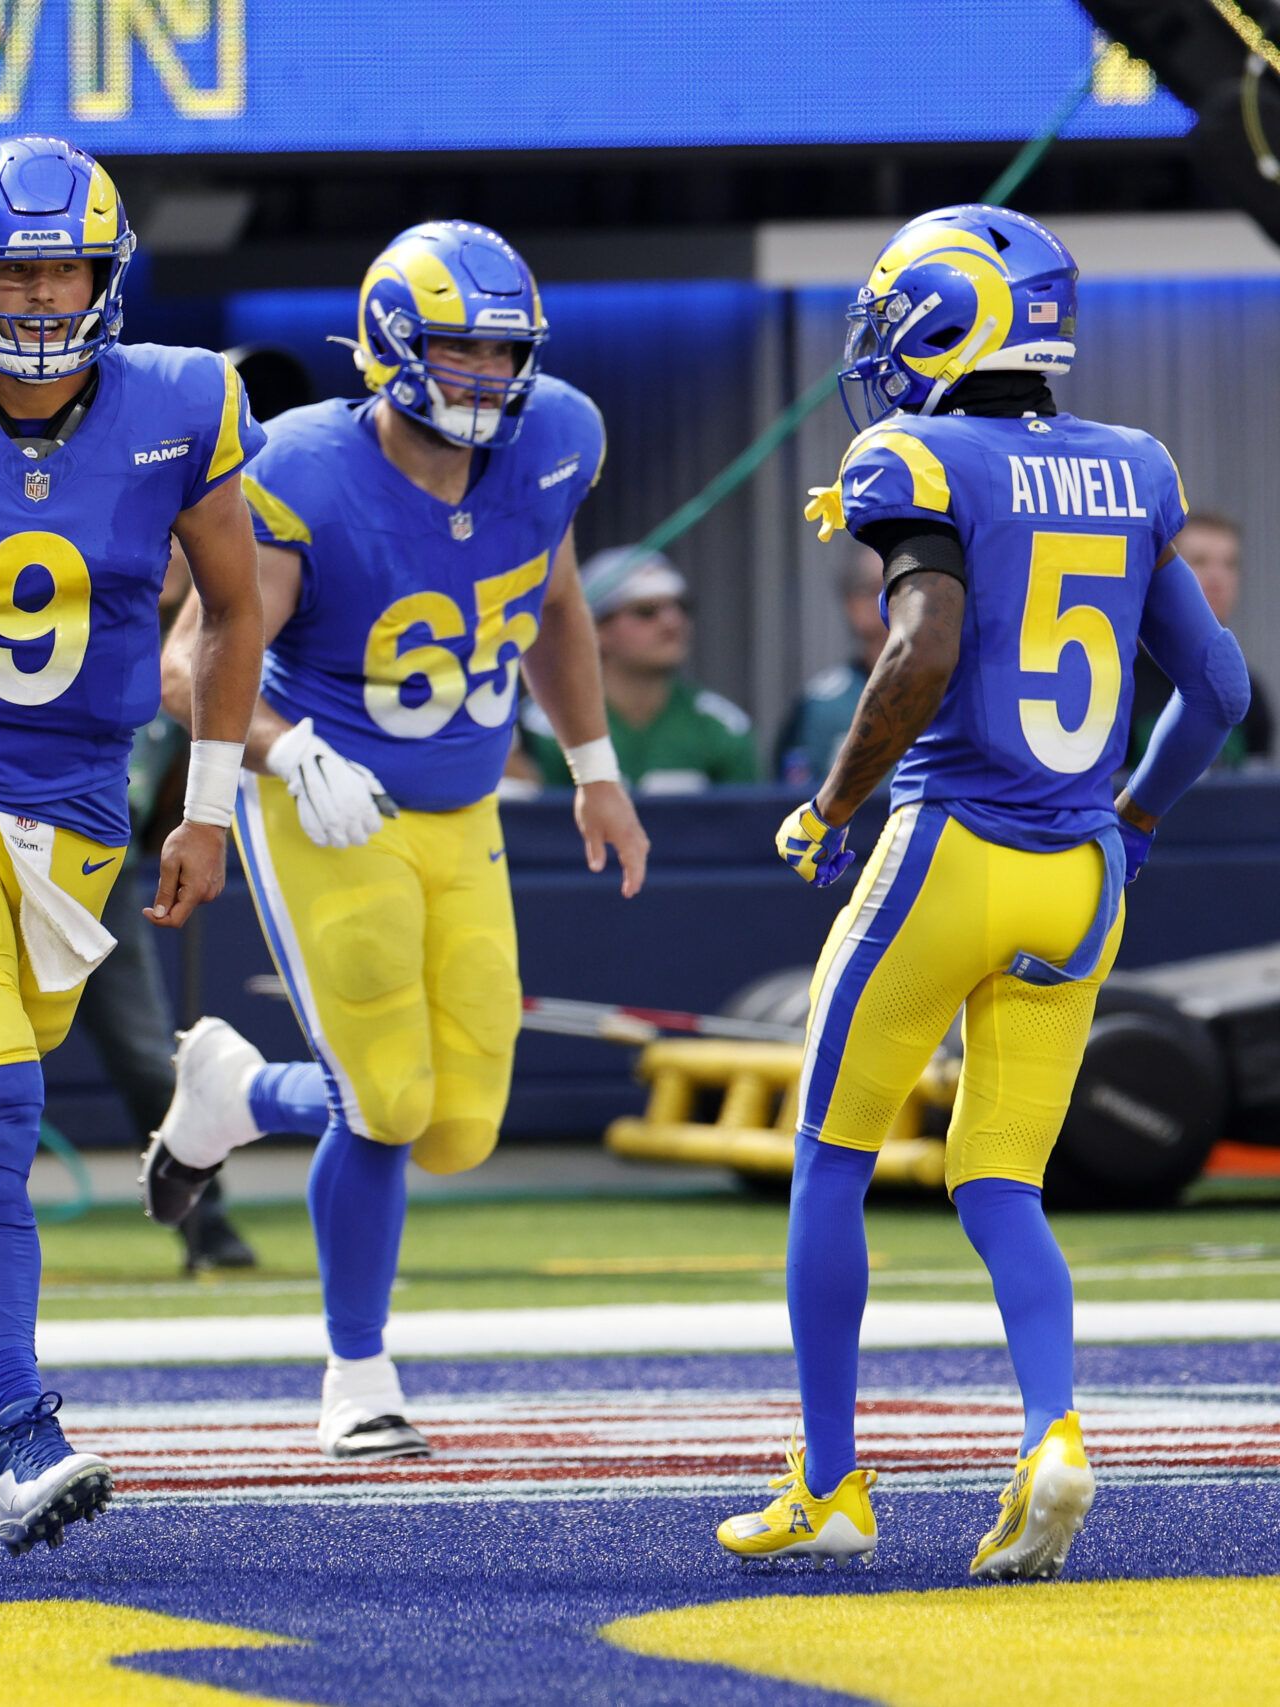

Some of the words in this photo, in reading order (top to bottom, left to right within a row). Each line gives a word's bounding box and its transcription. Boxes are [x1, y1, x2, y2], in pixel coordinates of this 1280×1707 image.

[22, 233, 61, 241] RAMS
[1025, 353, 1053, 363] LOS
[134, 444, 190, 465] RAMS
[28, 484, 47, 496] NFL
[1008, 455, 1147, 518] ATWELL
[363, 549, 549, 739] 65
[1018, 531, 1128, 774] 5
